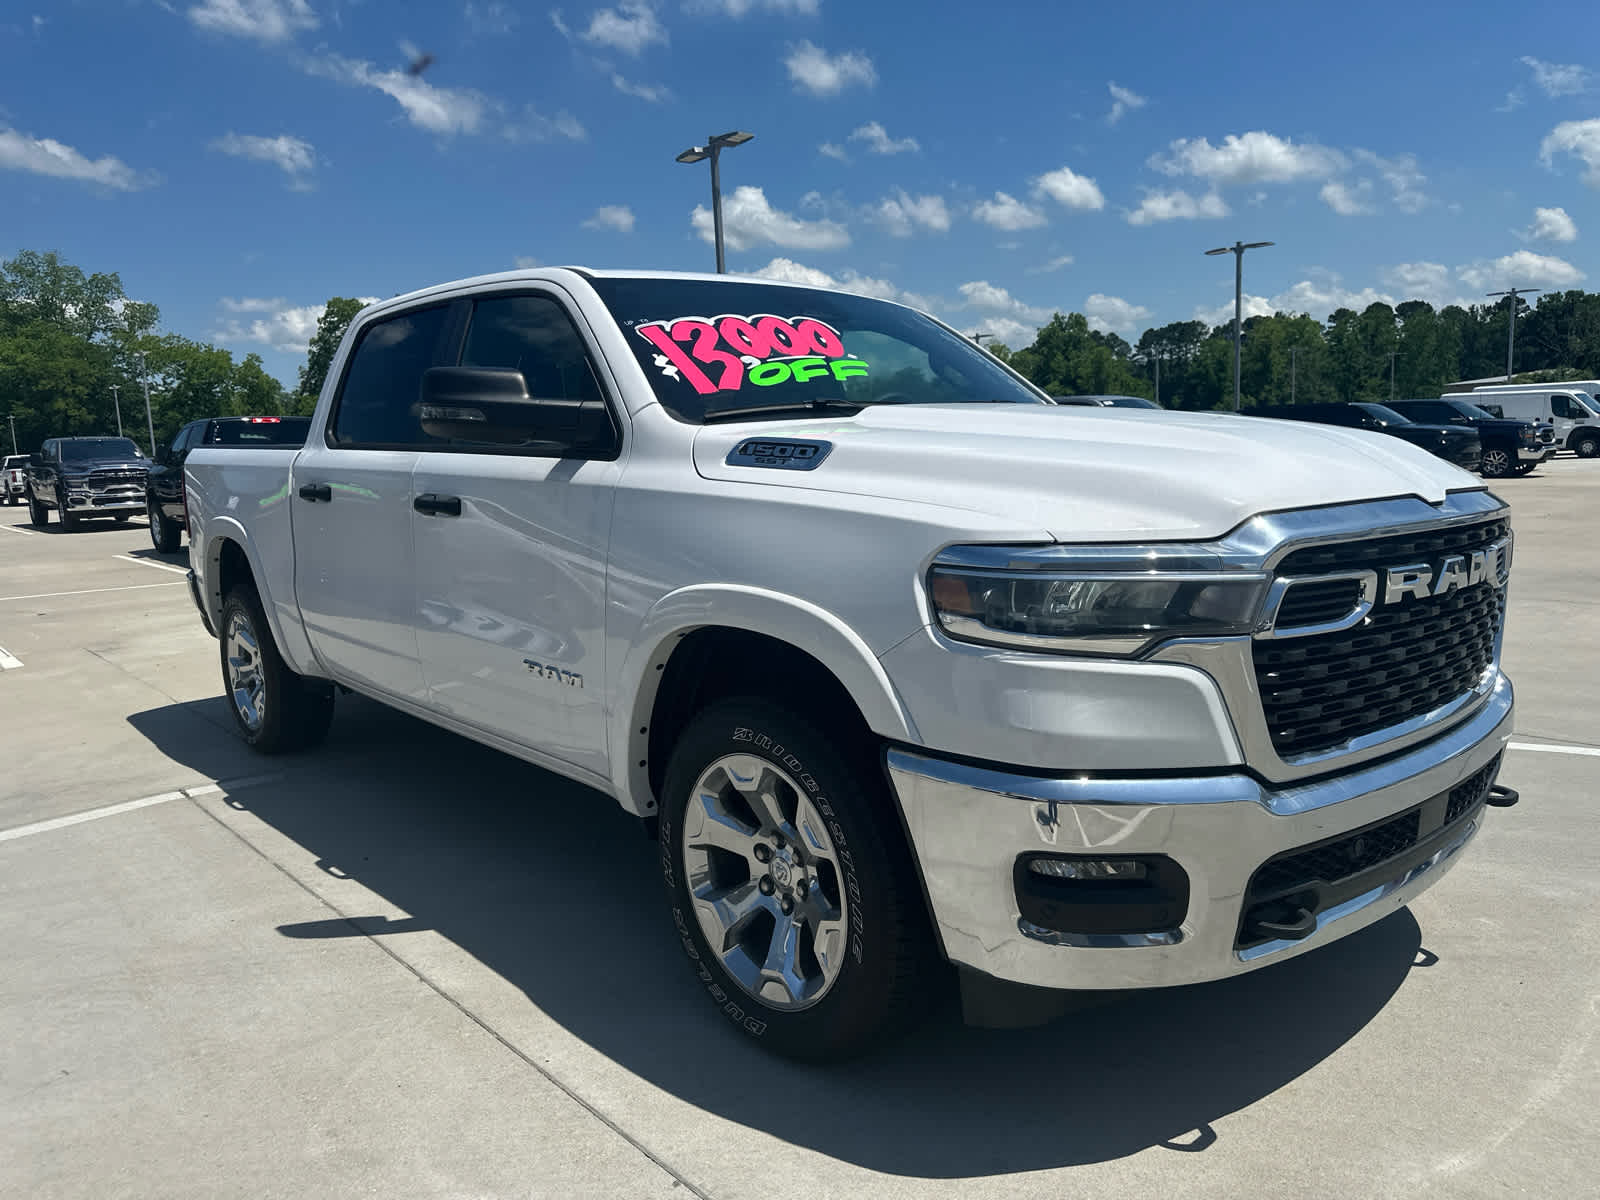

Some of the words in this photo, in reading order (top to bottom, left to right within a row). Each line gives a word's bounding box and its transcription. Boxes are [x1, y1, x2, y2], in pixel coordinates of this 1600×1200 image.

[749, 358, 869, 387] OFF
[739, 441, 819, 460] 1500
[1384, 551, 1488, 605] RAM
[523, 659, 584, 689] RAM
[732, 727, 863, 964] BRIDGESTONE
[672, 906, 768, 1036] DUELER
